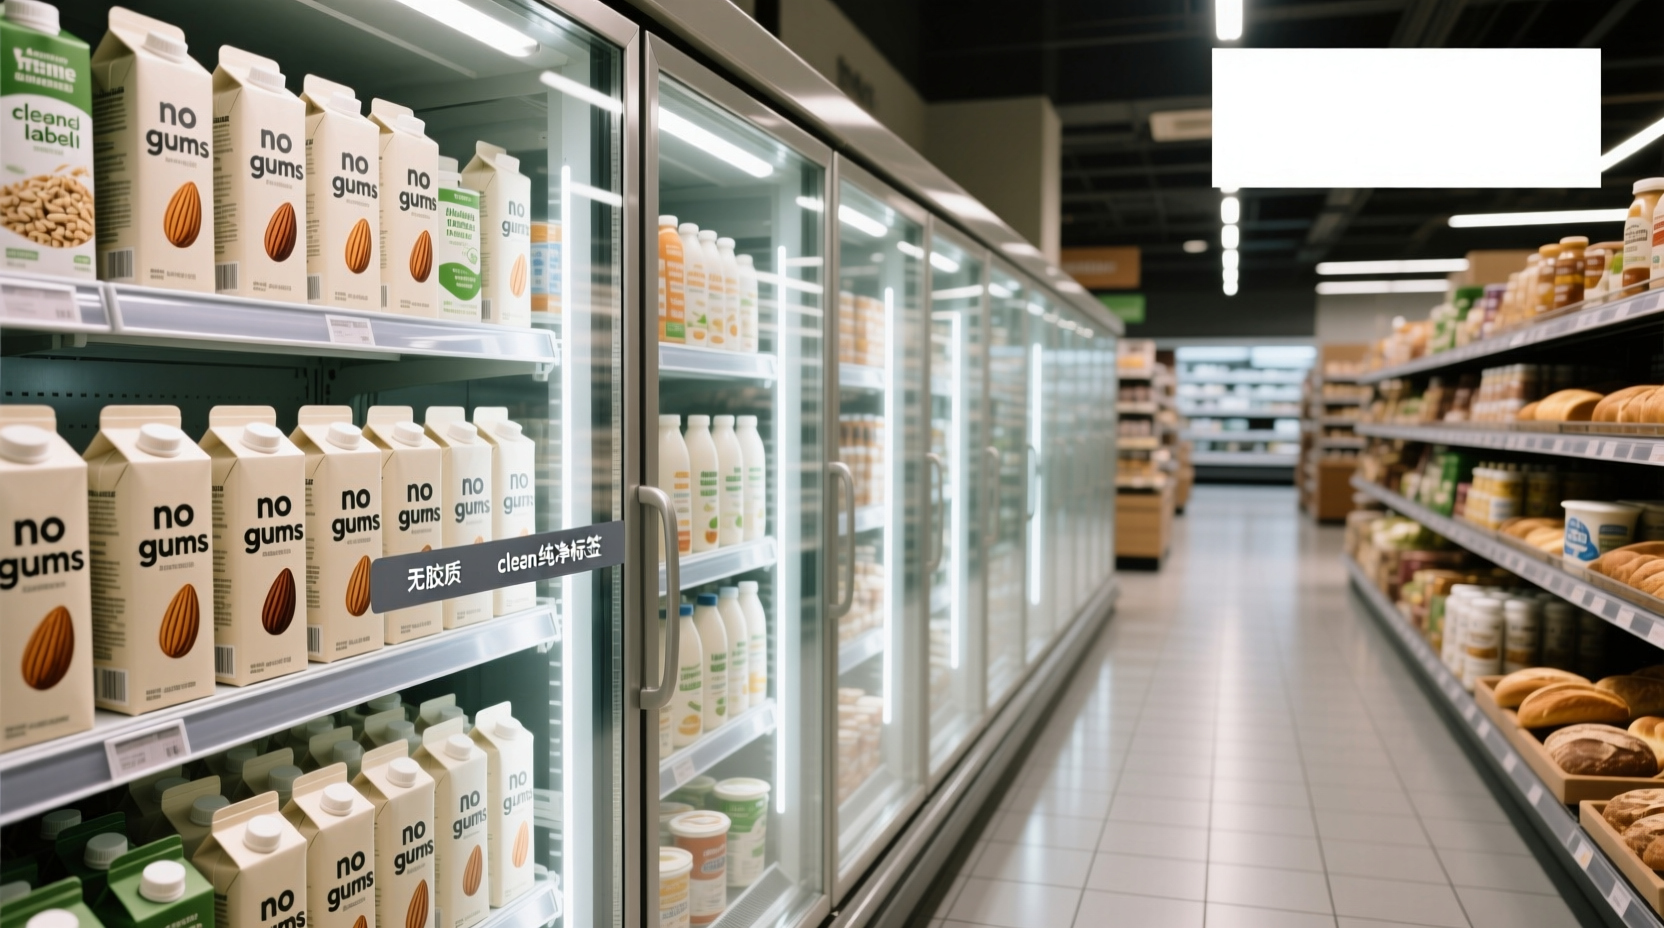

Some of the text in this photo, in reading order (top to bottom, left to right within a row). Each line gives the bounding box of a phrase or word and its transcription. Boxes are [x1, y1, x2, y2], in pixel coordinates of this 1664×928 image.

[160, 102, 197, 129] no
[146, 128, 210, 158] gums
[261, 128, 293, 154] no
[250, 154, 304, 181] gums
[342, 151, 369, 175] no
[332, 175, 378, 199] gums
[408, 168, 430, 190] no
[399, 190, 437, 211] gums
[509, 200, 525, 218] no
[408, 482, 433, 502] no
[462, 477, 484, 496] no
[509, 472, 529, 490] no
[258, 495, 292, 519] no
[341, 488, 371, 510] no
[455, 499, 490, 524] gums
[153, 503, 195, 530] no
[332, 513, 380, 542] gums
[399, 506, 441, 532] gums
[14, 516, 66, 547] no
[244, 523, 304, 554] gums
[138, 533, 209, 568] gums
[0, 549, 84, 590] gums
[407, 559, 462, 593] 无胶质
[509, 770, 527, 791] no
[460, 790, 480, 813] no
[402, 820, 426, 846] no
[453, 807, 487, 840] gums
[337, 851, 365, 879] no
[394, 839, 434, 876] gums
[327, 871, 374, 913] gums
[261, 889, 295, 922] no
